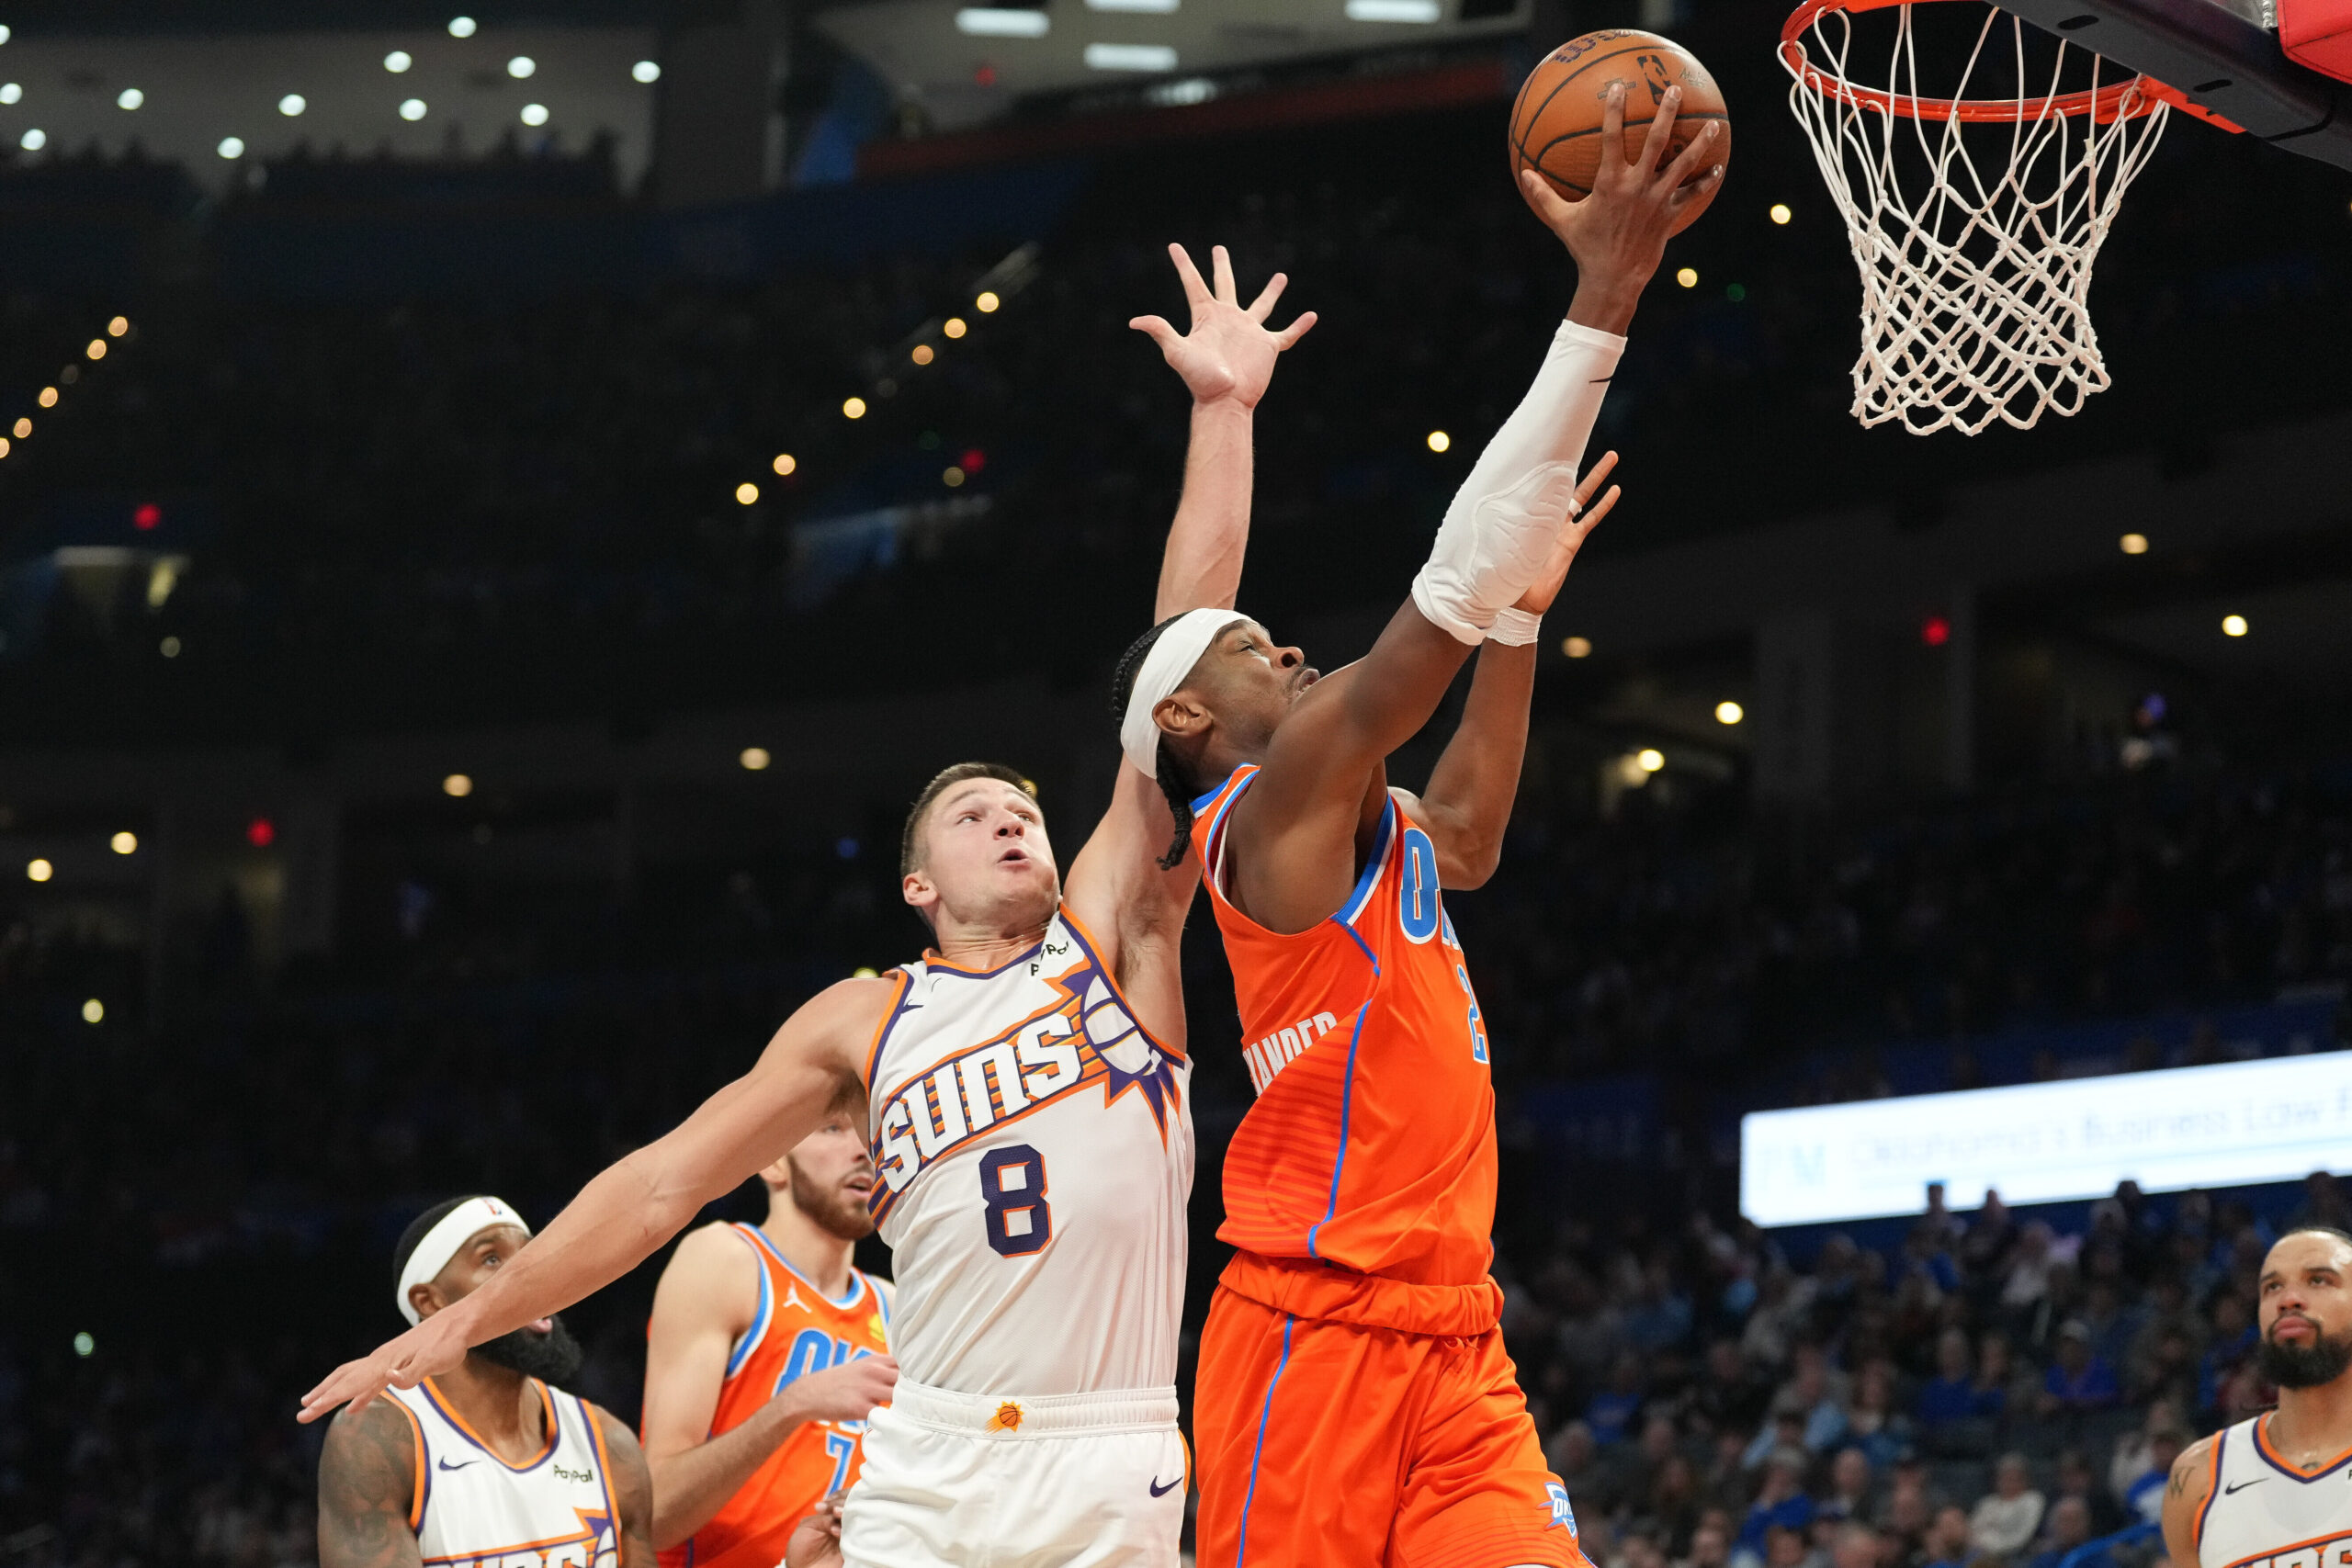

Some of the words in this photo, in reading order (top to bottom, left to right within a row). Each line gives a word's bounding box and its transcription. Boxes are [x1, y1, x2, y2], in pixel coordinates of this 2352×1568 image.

[880, 1012, 1082, 1193] SUNS
[978, 1144, 1053, 1258] 8
[553, 1463, 593, 1484] PayPal
[815, 1430, 856, 1501] 7
